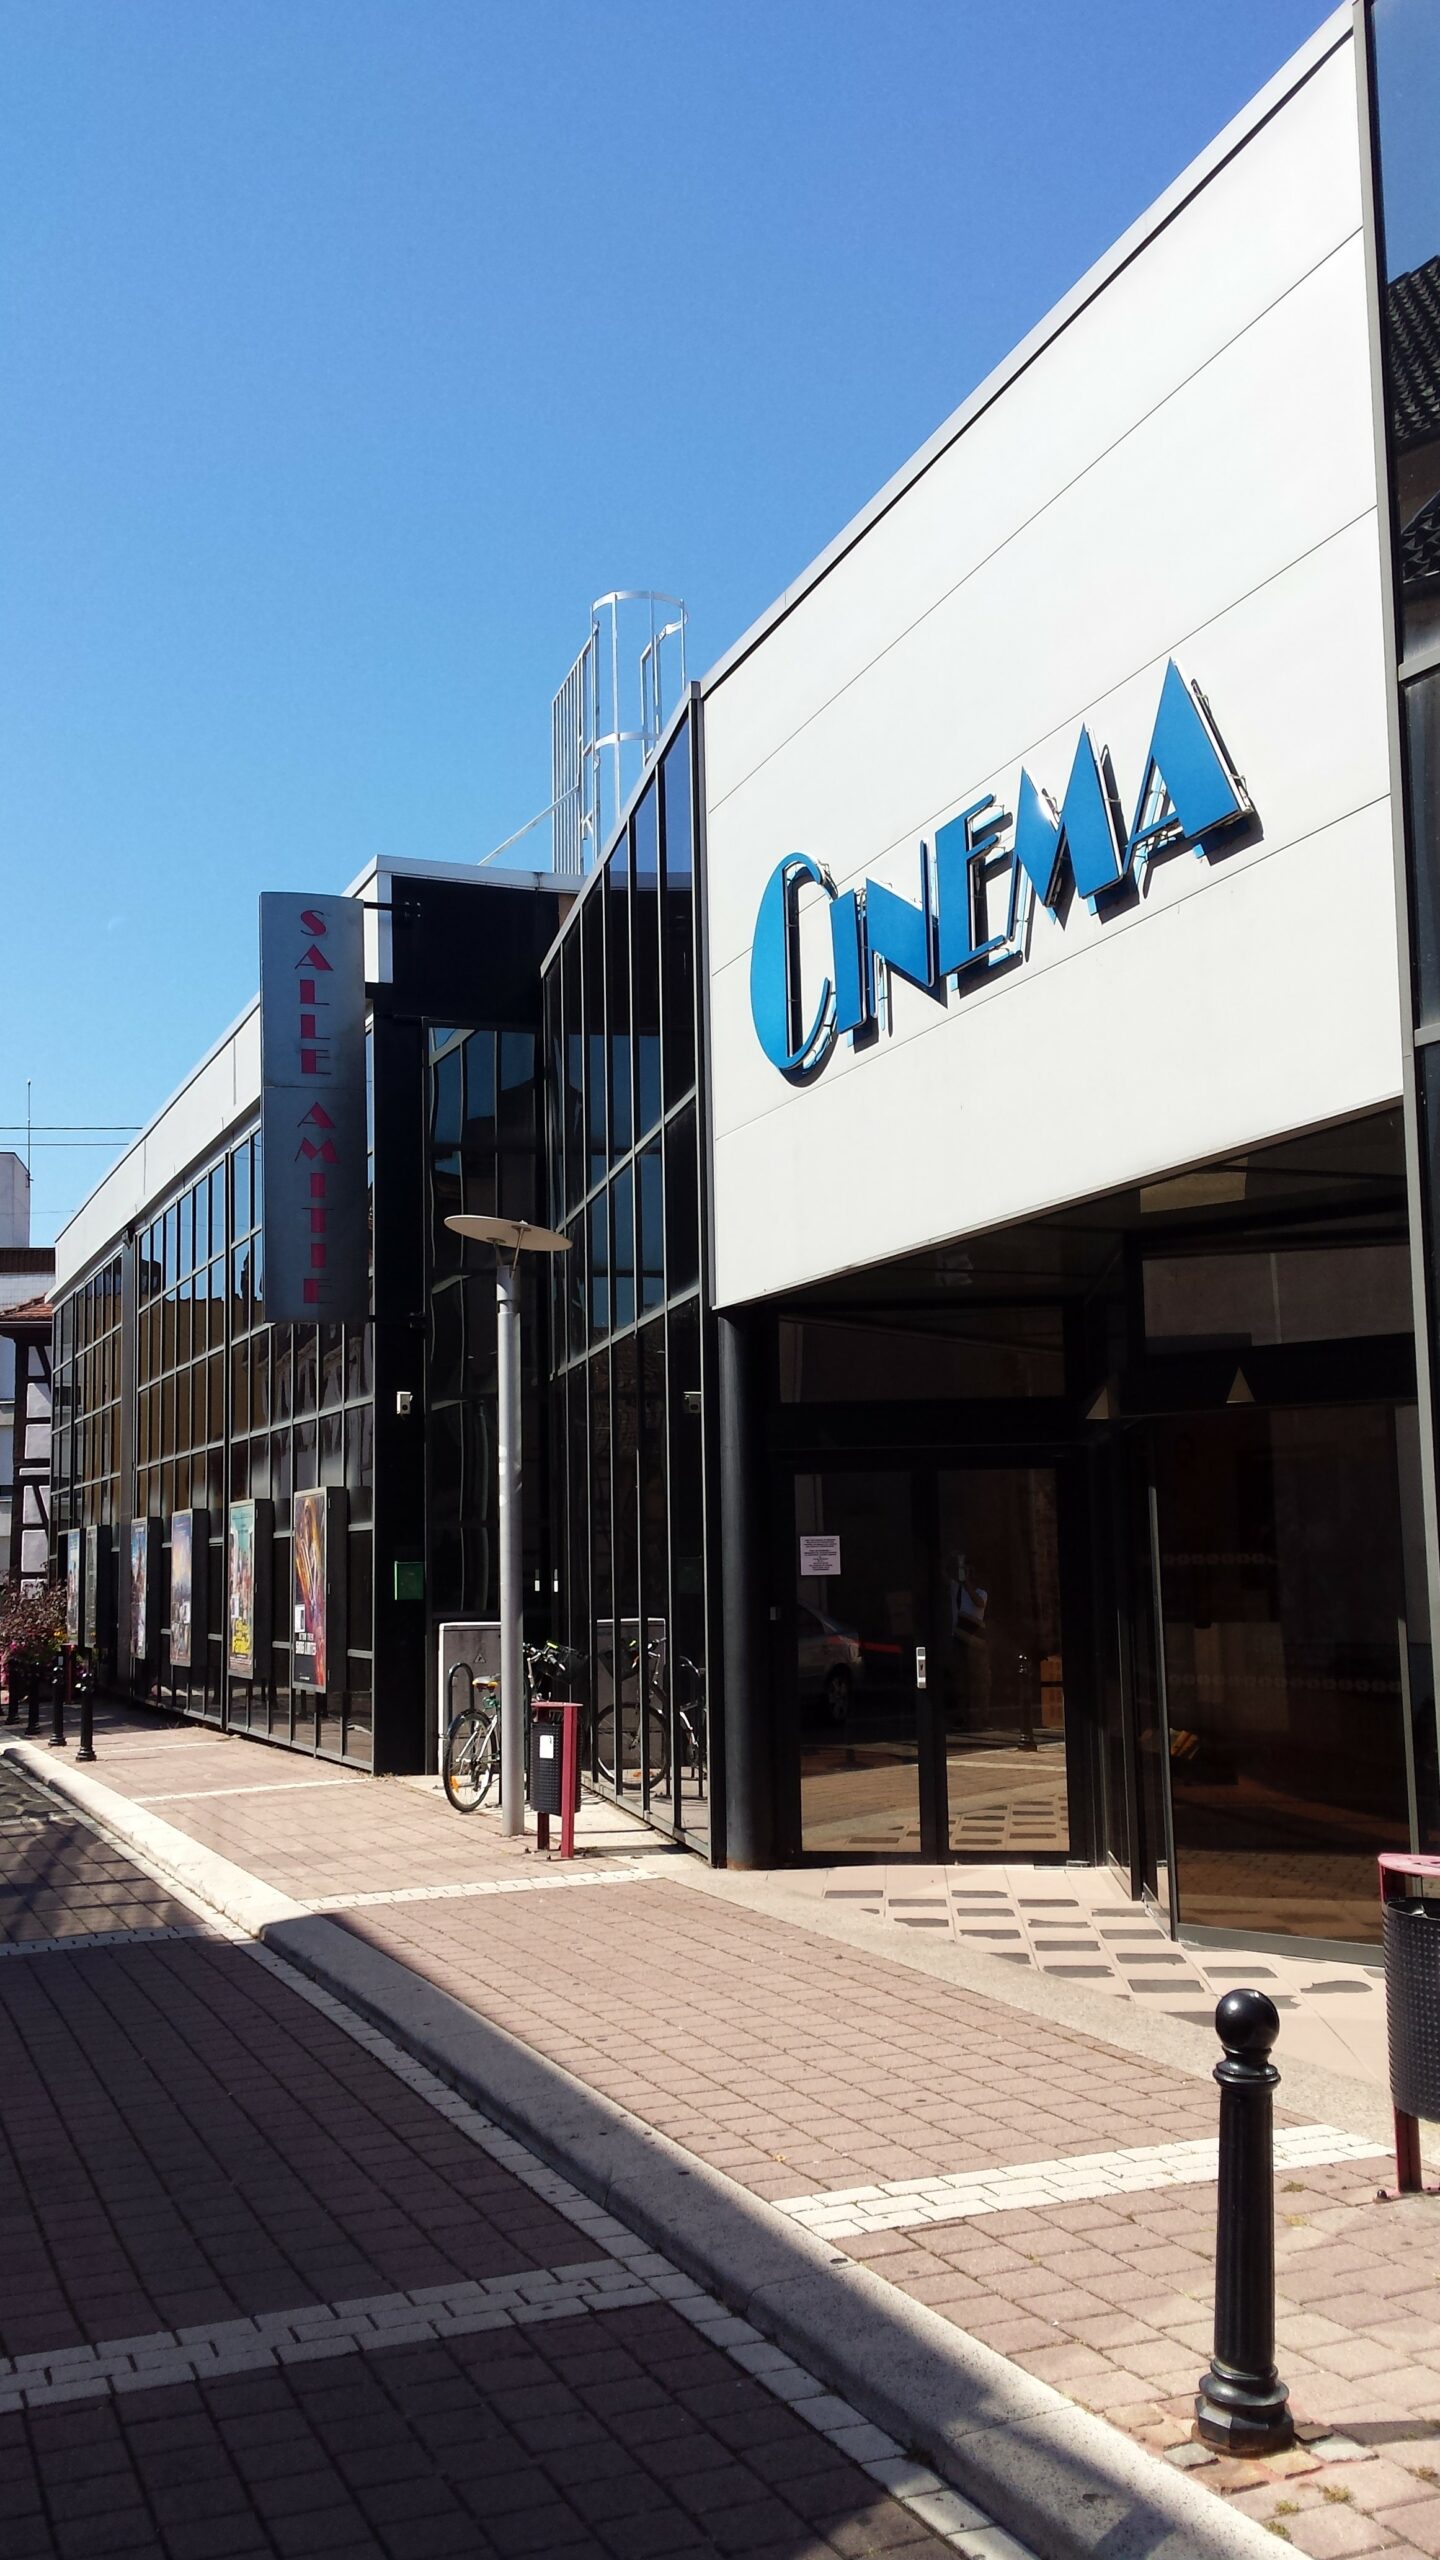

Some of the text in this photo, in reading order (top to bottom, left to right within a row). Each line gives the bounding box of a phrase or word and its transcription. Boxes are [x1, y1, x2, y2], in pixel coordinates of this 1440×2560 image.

[750, 656, 1252, 1070] CINEMA
[294, 909, 340, 1304] SALLE AMITIE
